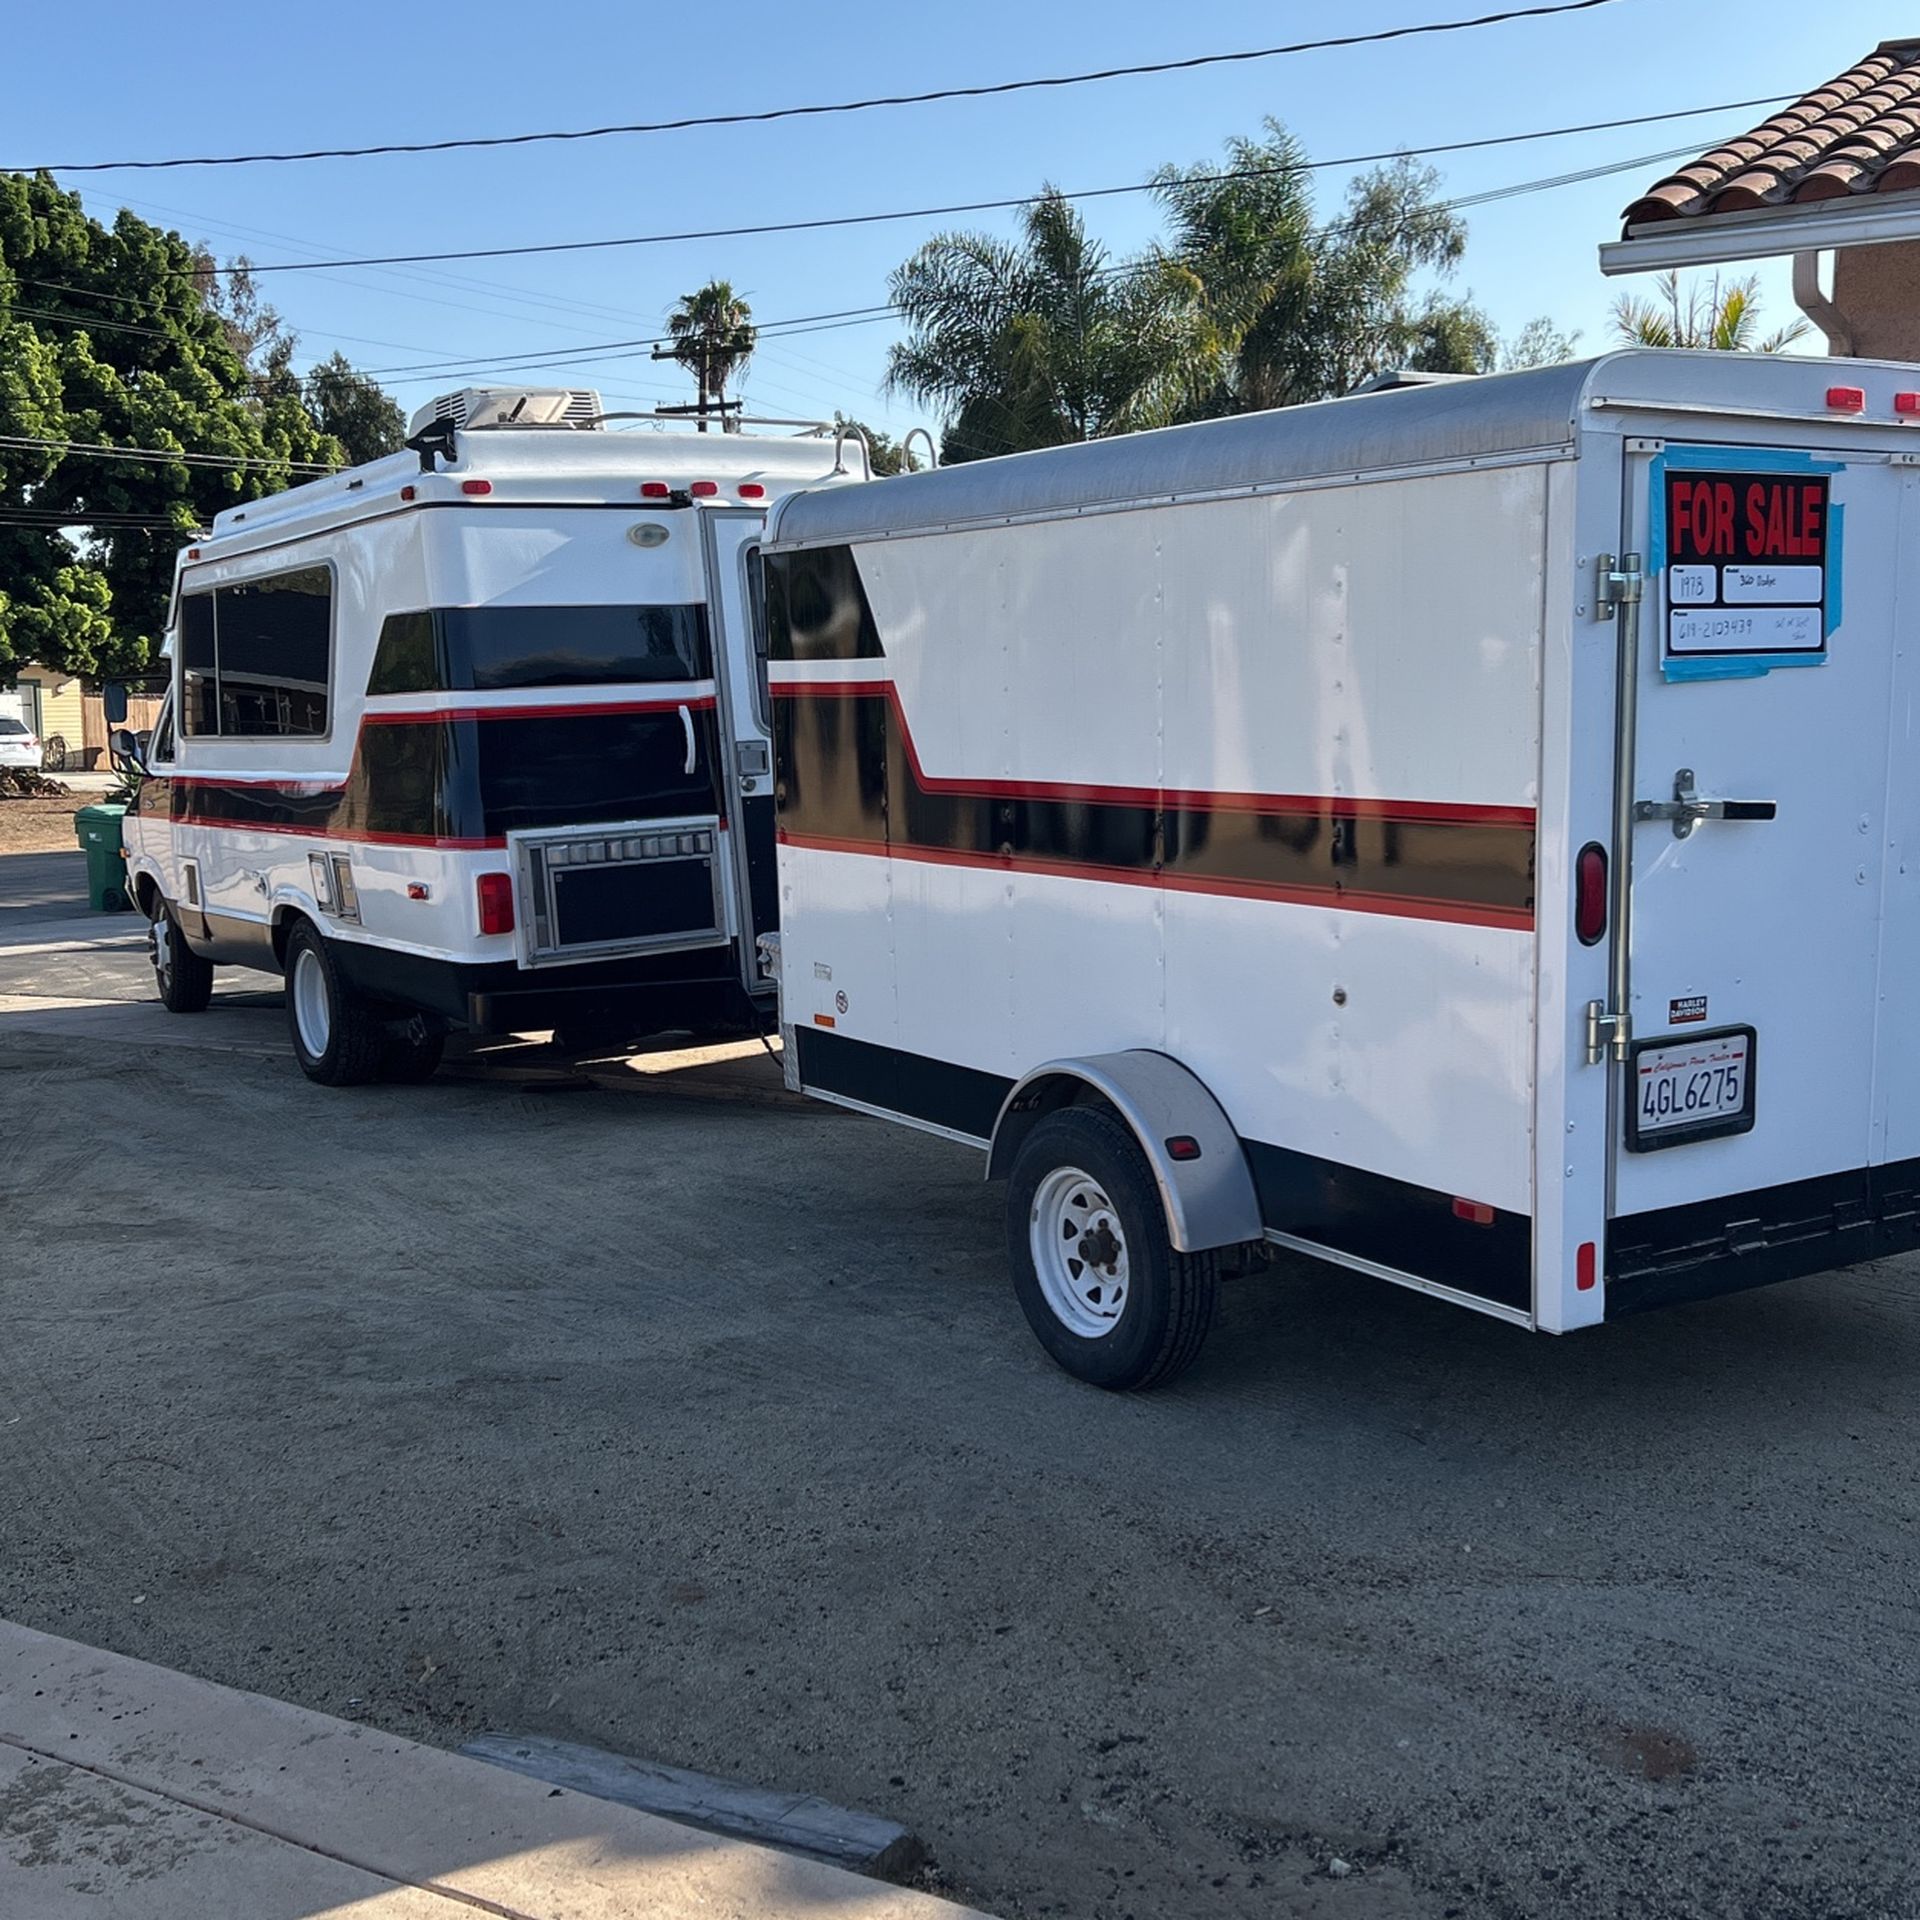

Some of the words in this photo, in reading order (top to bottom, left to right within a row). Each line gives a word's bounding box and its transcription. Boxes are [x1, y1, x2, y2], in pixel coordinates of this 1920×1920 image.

[1672, 481, 1735, 556] FOR
[1746, 482, 1822, 557] SALE
[1671, 1006, 1705, 1018] DAVIDSON
[1643, 1064, 1738, 1118] 4GL6275
